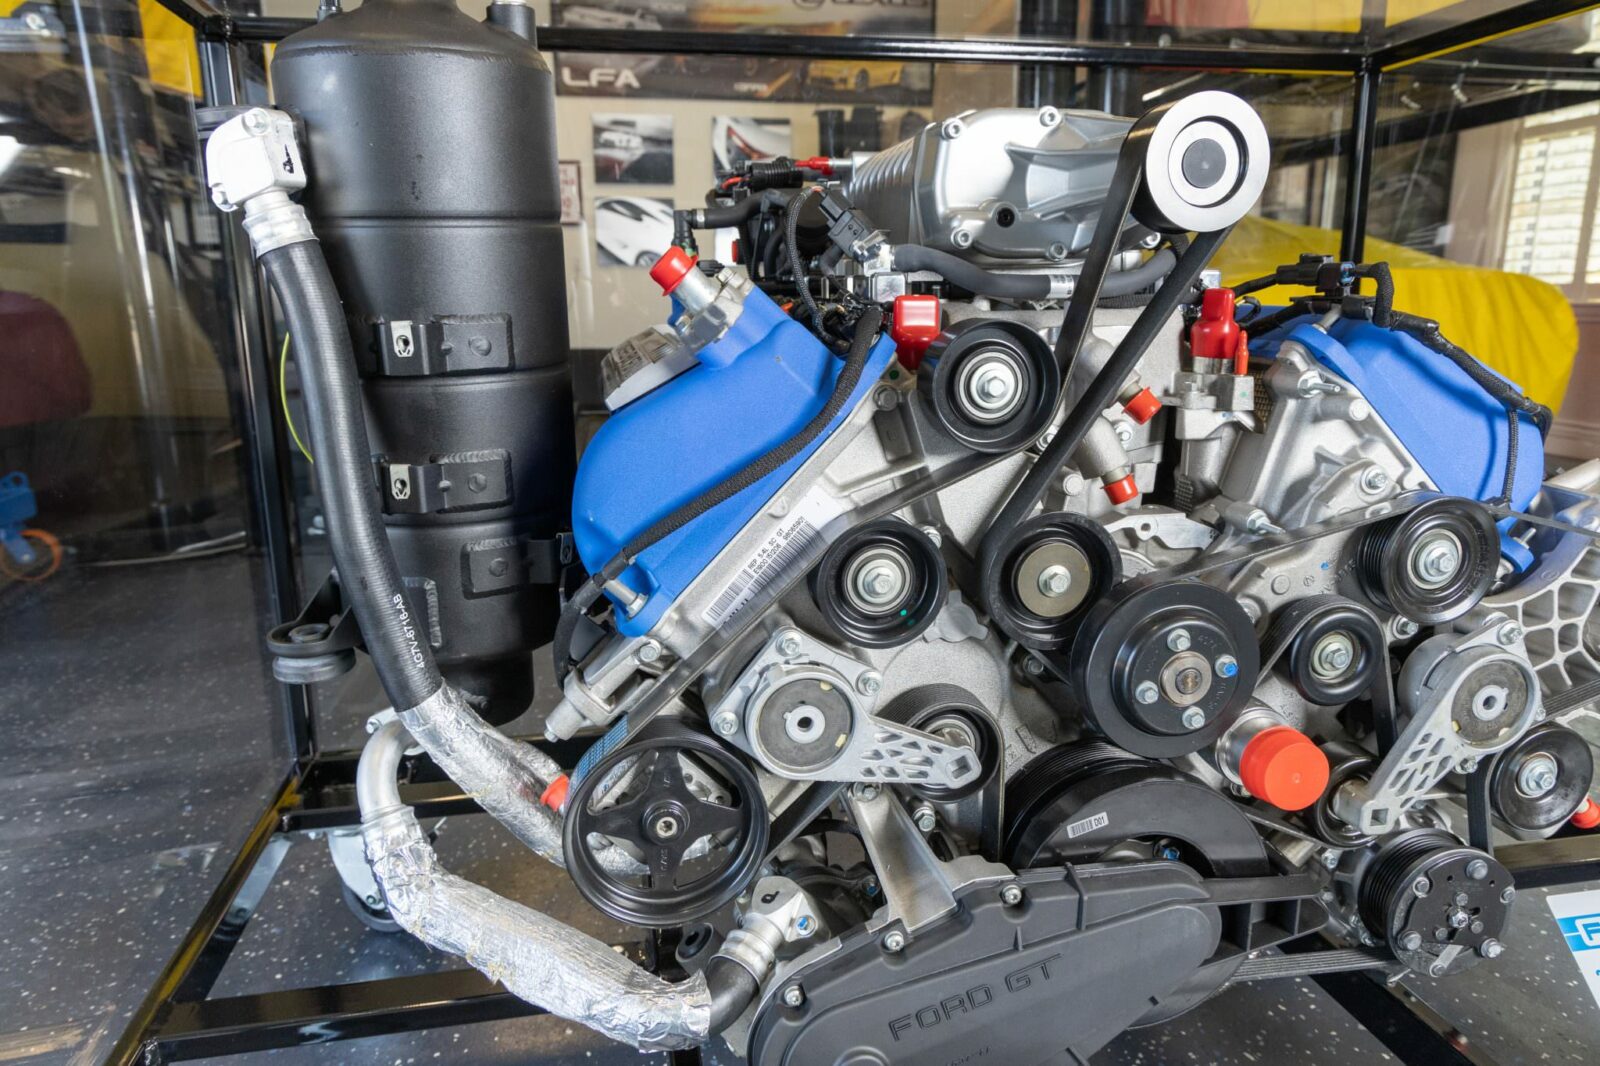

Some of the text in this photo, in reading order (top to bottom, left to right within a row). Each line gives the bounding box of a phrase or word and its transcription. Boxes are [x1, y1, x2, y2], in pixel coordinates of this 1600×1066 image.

[561, 66, 641, 89] LFA
[888, 953, 1064, 1042] FORD GT
